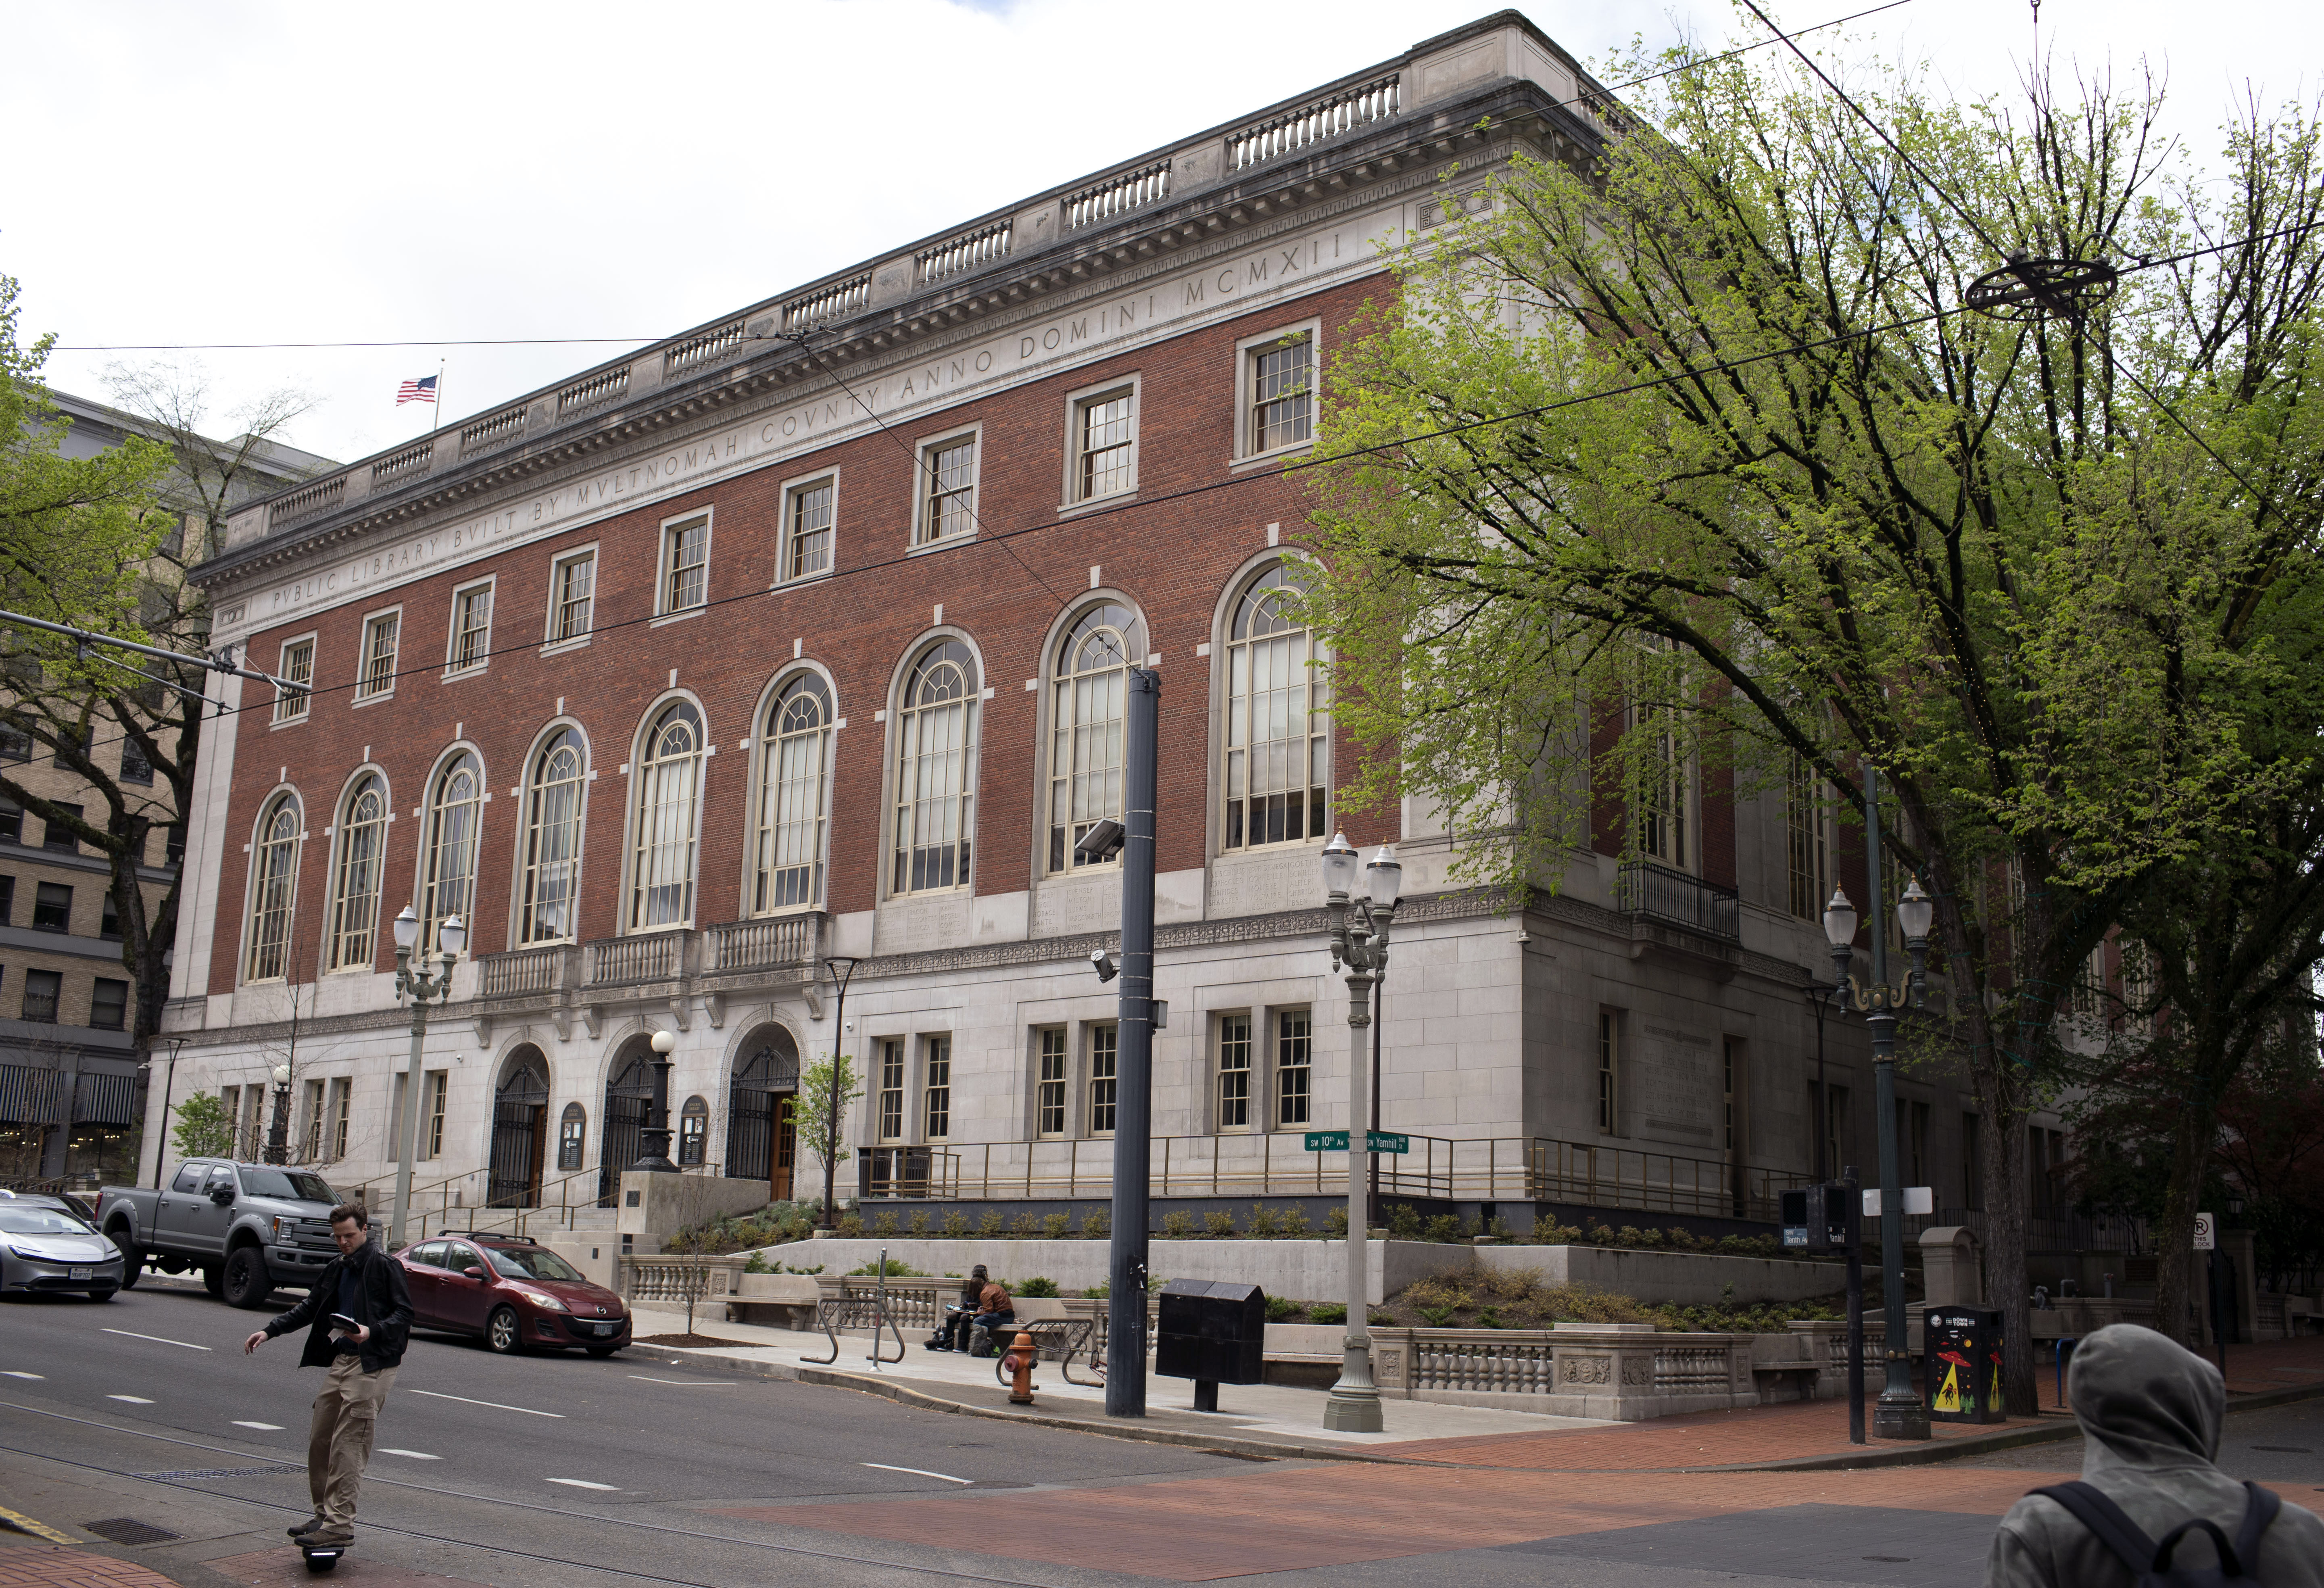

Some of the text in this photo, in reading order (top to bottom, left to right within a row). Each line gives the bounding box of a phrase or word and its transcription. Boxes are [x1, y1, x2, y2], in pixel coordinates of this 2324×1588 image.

[273, 234, 1339, 608] PVBLIC LIBRARY BVILT BY MVLTNOMAH COVNTY ANNO DOMINI MCMXII
[1289, 859, 1318, 868] GOETHE
[1289, 868, 1319, 878] SCHILLER
[1209, 888, 1238, 897] EURIPIDES
[1289, 887, 1321, 897] SHERIDAN
[1248, 902, 1277, 911] LESSING
[1289, 898, 1308, 906] IBSEN
[1032, 926, 1058, 935] CHAUCER
[1322, 1136, 1334, 1146] 10th
[1377, 1137, 1396, 1149] Yamhill
[1830, 1234, 1845, 1243] Yamhill
